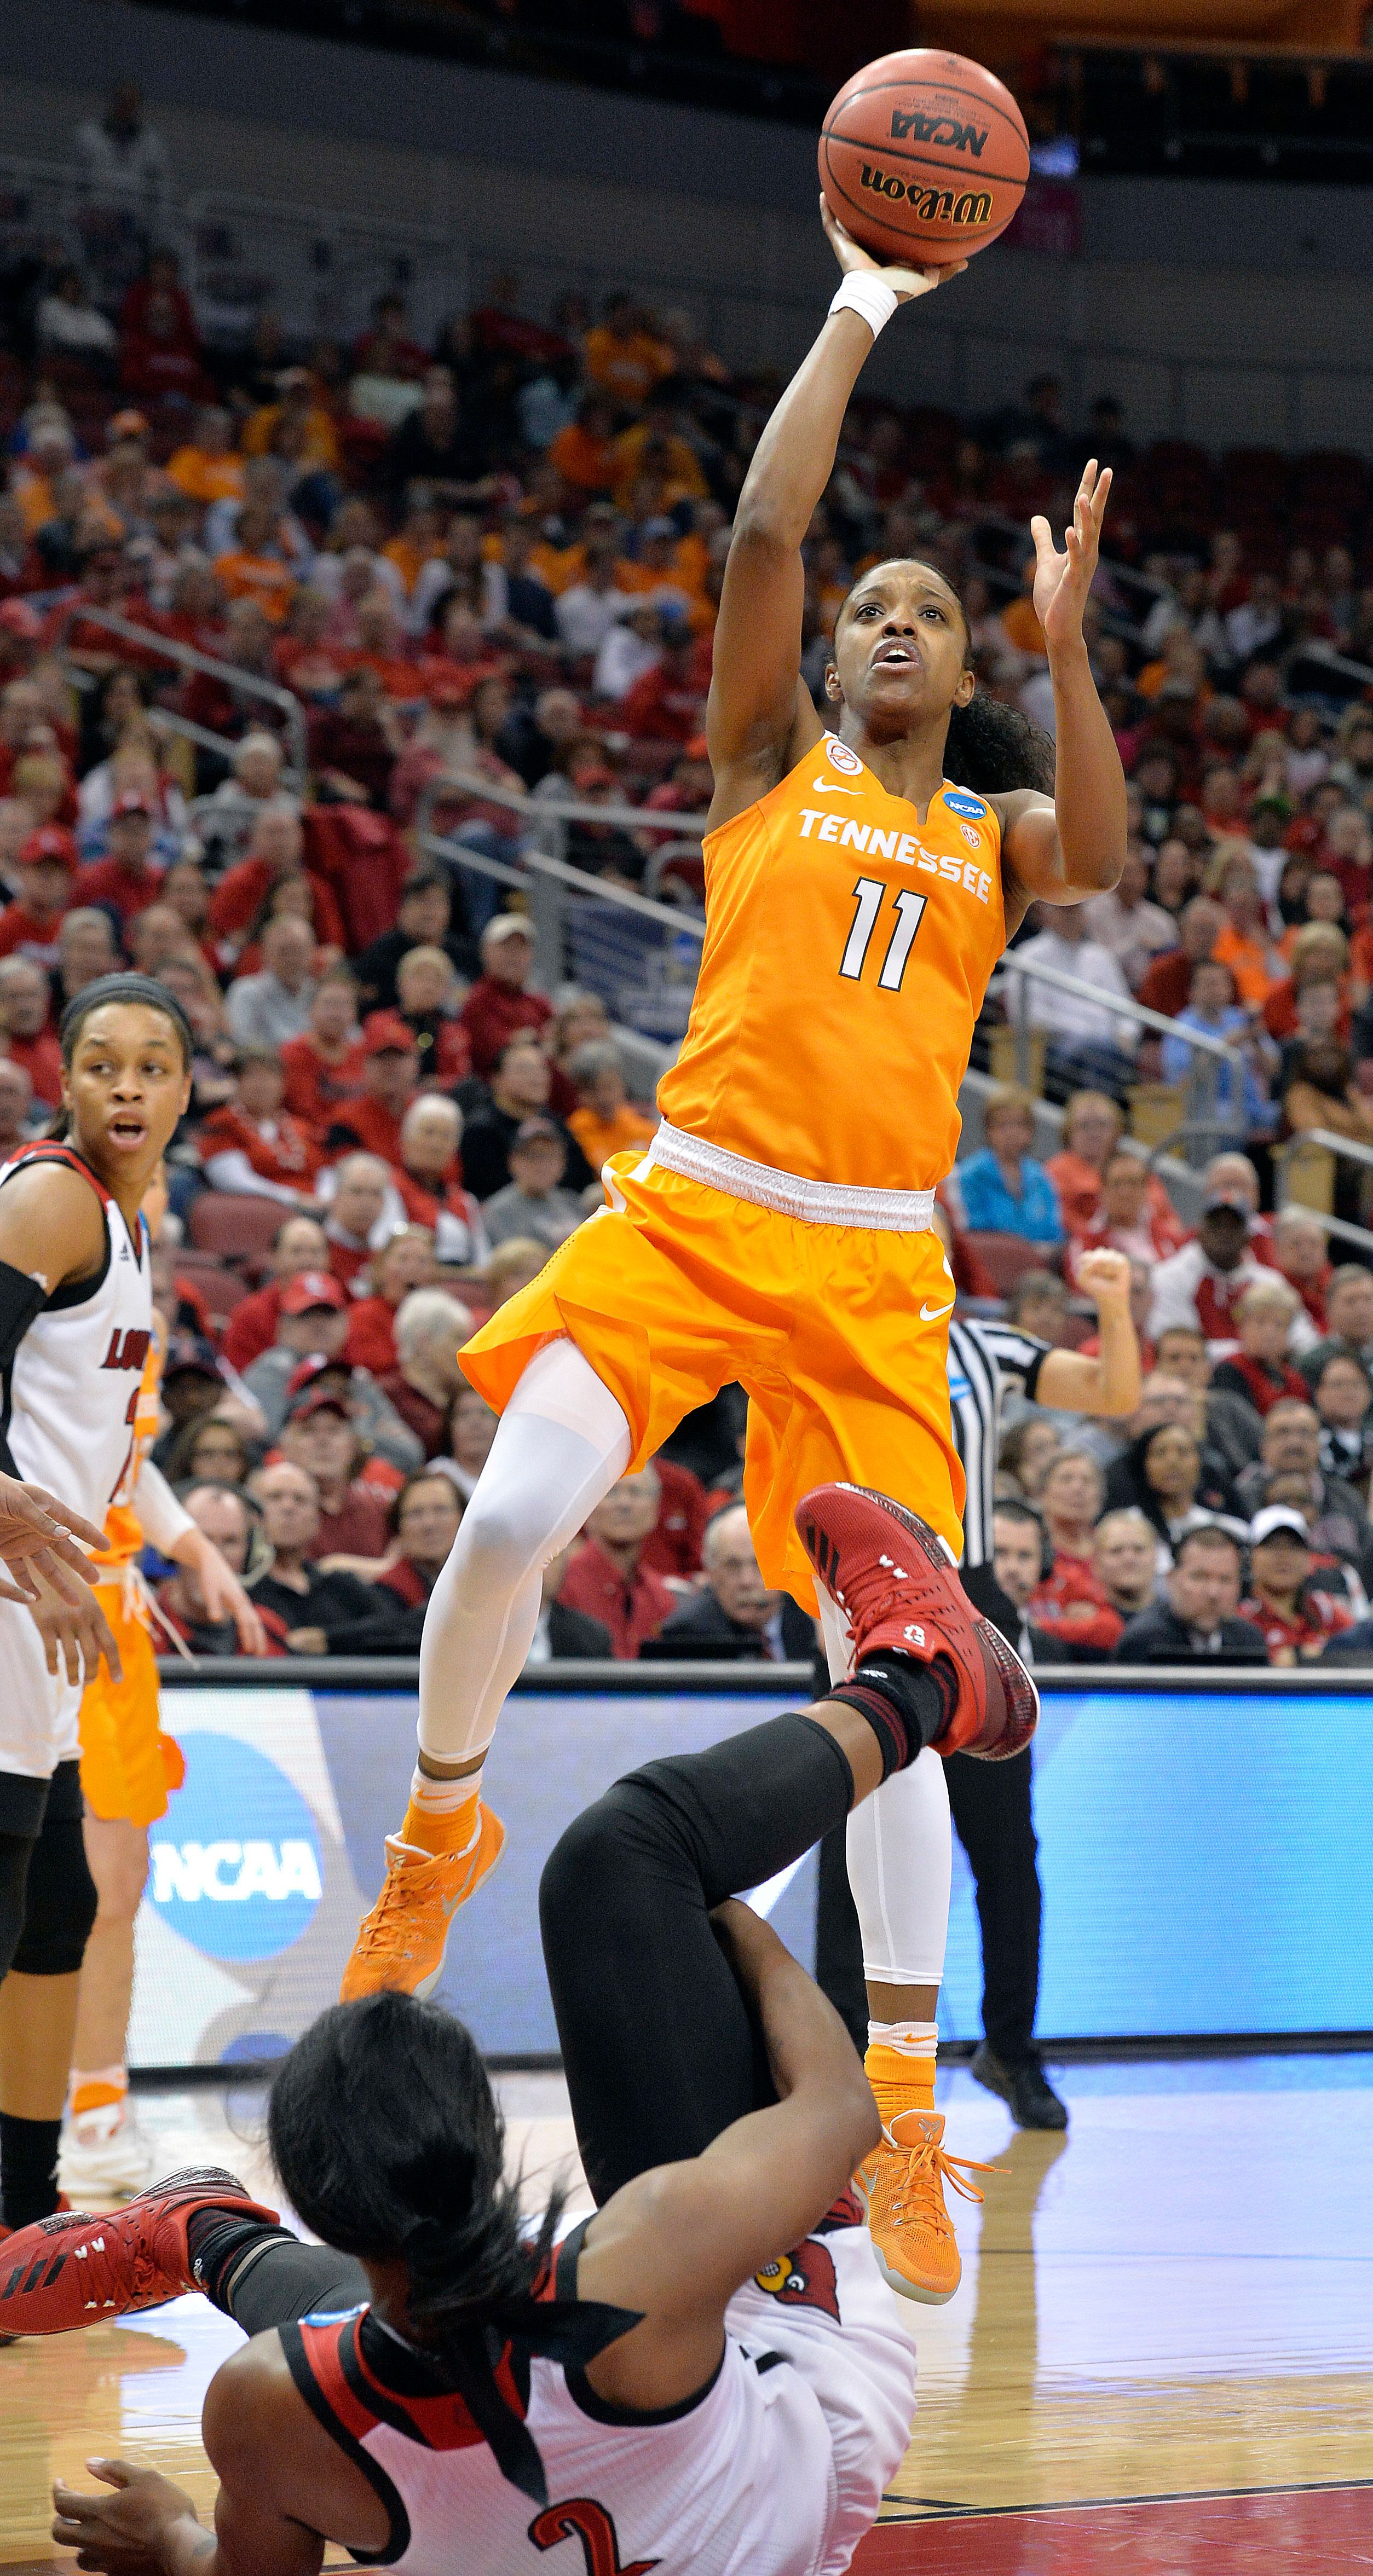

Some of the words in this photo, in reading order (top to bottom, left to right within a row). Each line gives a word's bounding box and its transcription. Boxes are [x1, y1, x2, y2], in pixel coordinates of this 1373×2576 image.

[890, 110, 989, 157] NCAA
[860, 164, 993, 225] Wilson
[949, 801, 984, 815] NCAA
[962, 826, 979, 847] SEC
[798, 808, 993, 905] TENNESSEE
[838, 876, 928, 993] 11
[151, 1840, 322, 1901] NCAA
